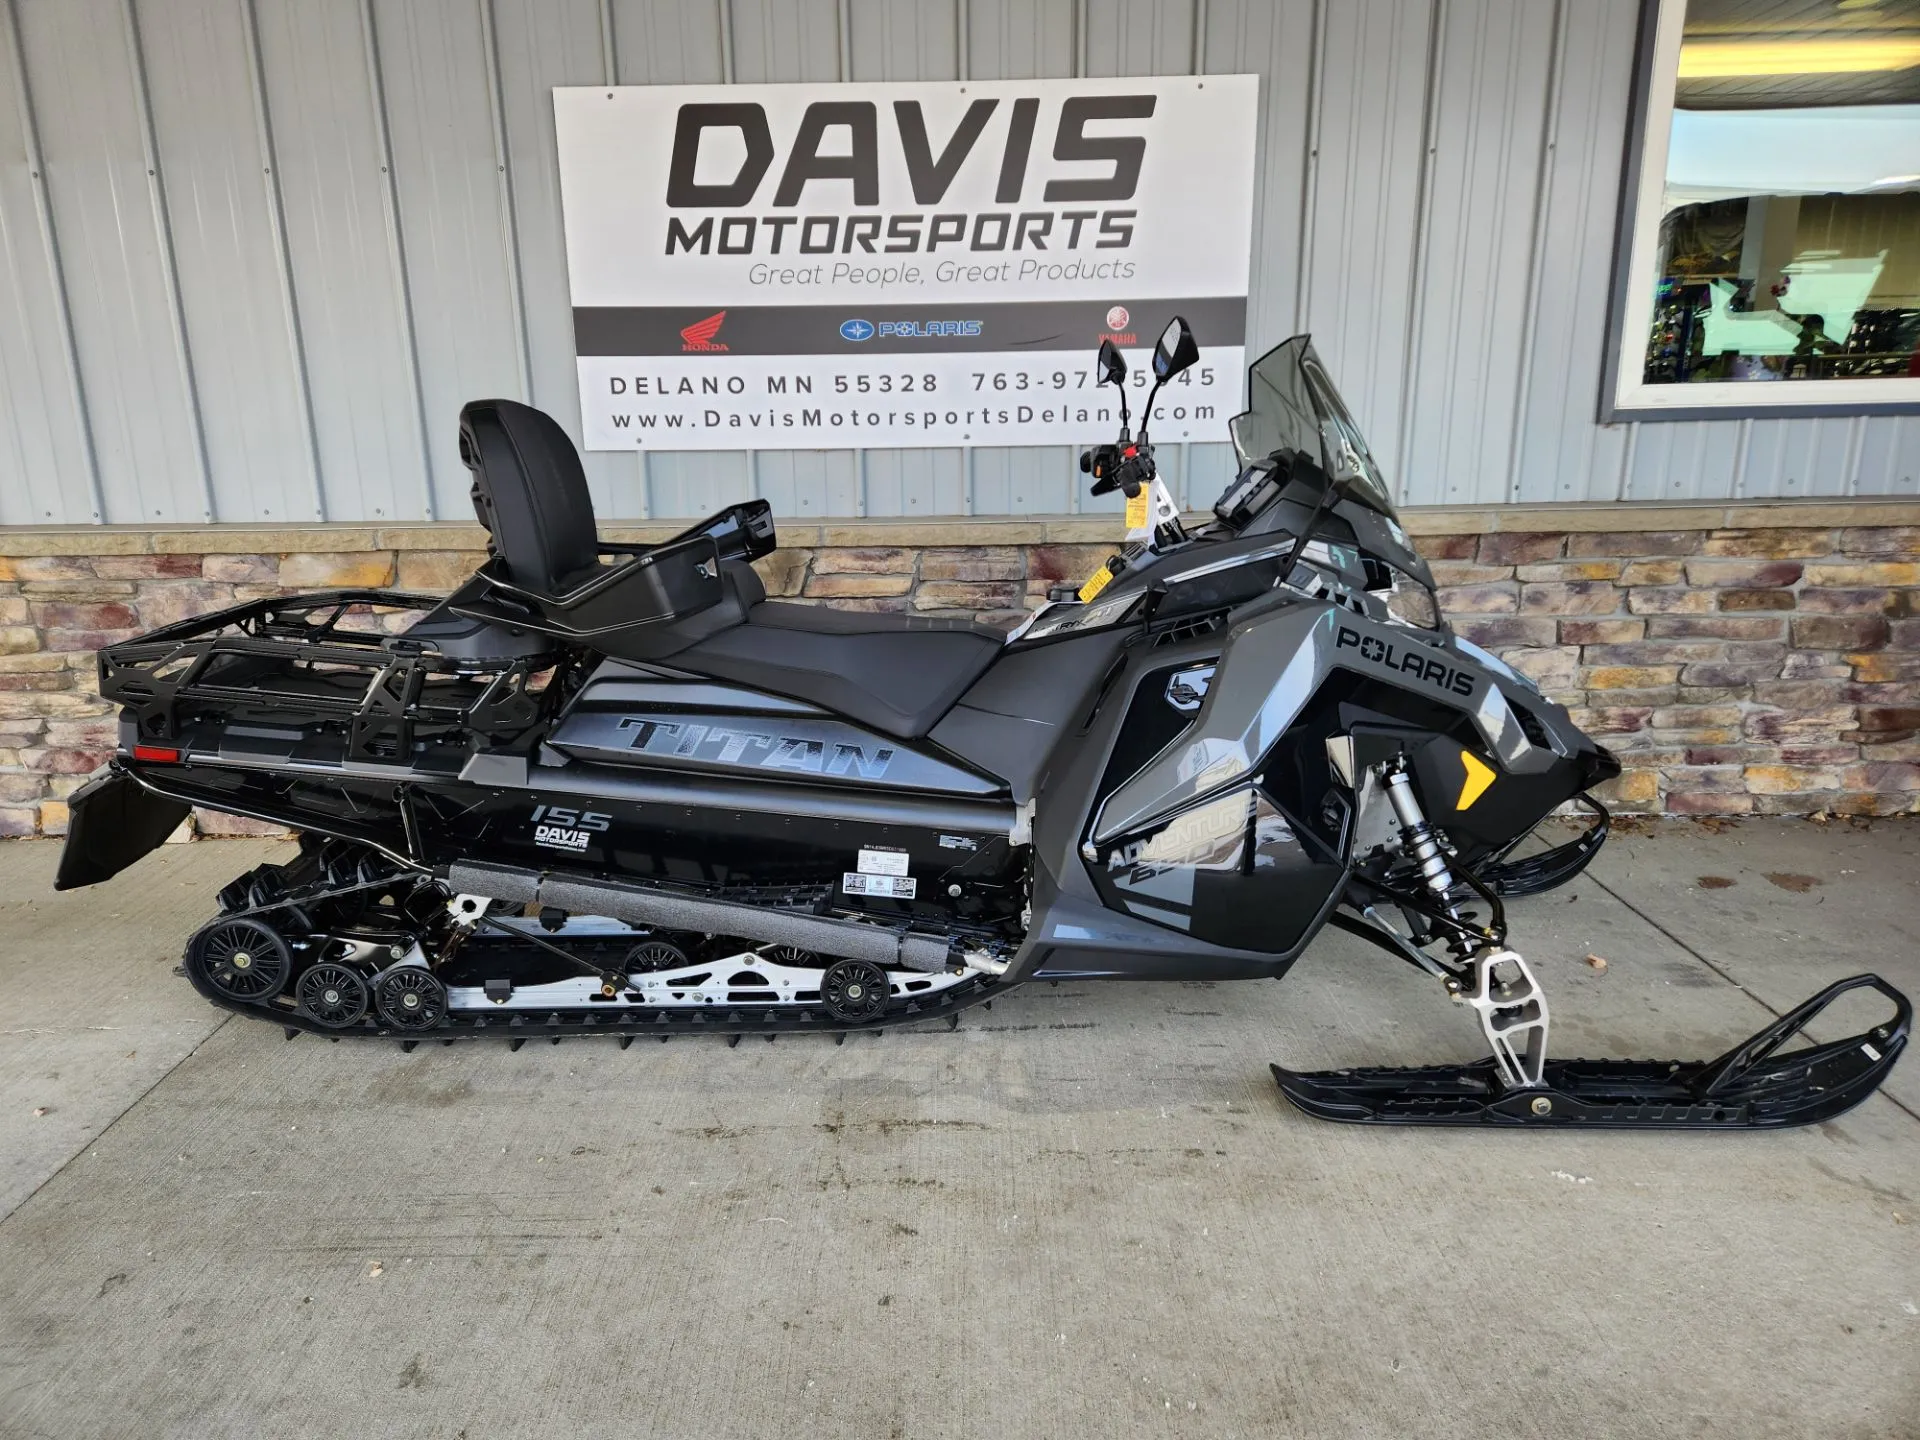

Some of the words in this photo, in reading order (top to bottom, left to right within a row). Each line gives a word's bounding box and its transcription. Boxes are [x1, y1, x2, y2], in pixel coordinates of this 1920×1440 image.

[665, 95, 1157, 208] DAVIS
[665, 210, 1138, 256] MOTORSPORTS
[748, 262, 823, 286] Great
[831, 261, 925, 288] People,
[935, 260, 1009, 284] Great
[1018, 258, 1136, 282] Products
[878, 320, 983, 337] POLARIS
[681, 343, 729, 352] HONDA
[609, 376, 745, 395] DELANO
[766, 375, 813, 394] MN
[834, 374, 937, 393] 55328
[611, 404, 1215, 429] www.DavisMotorsportsDelano.com
[1335, 625, 1475, 697] POLARIS
[618, 716, 895, 780] TITAN
[530, 804, 613, 832] 155
[534, 825, 591, 846] DAVIS
